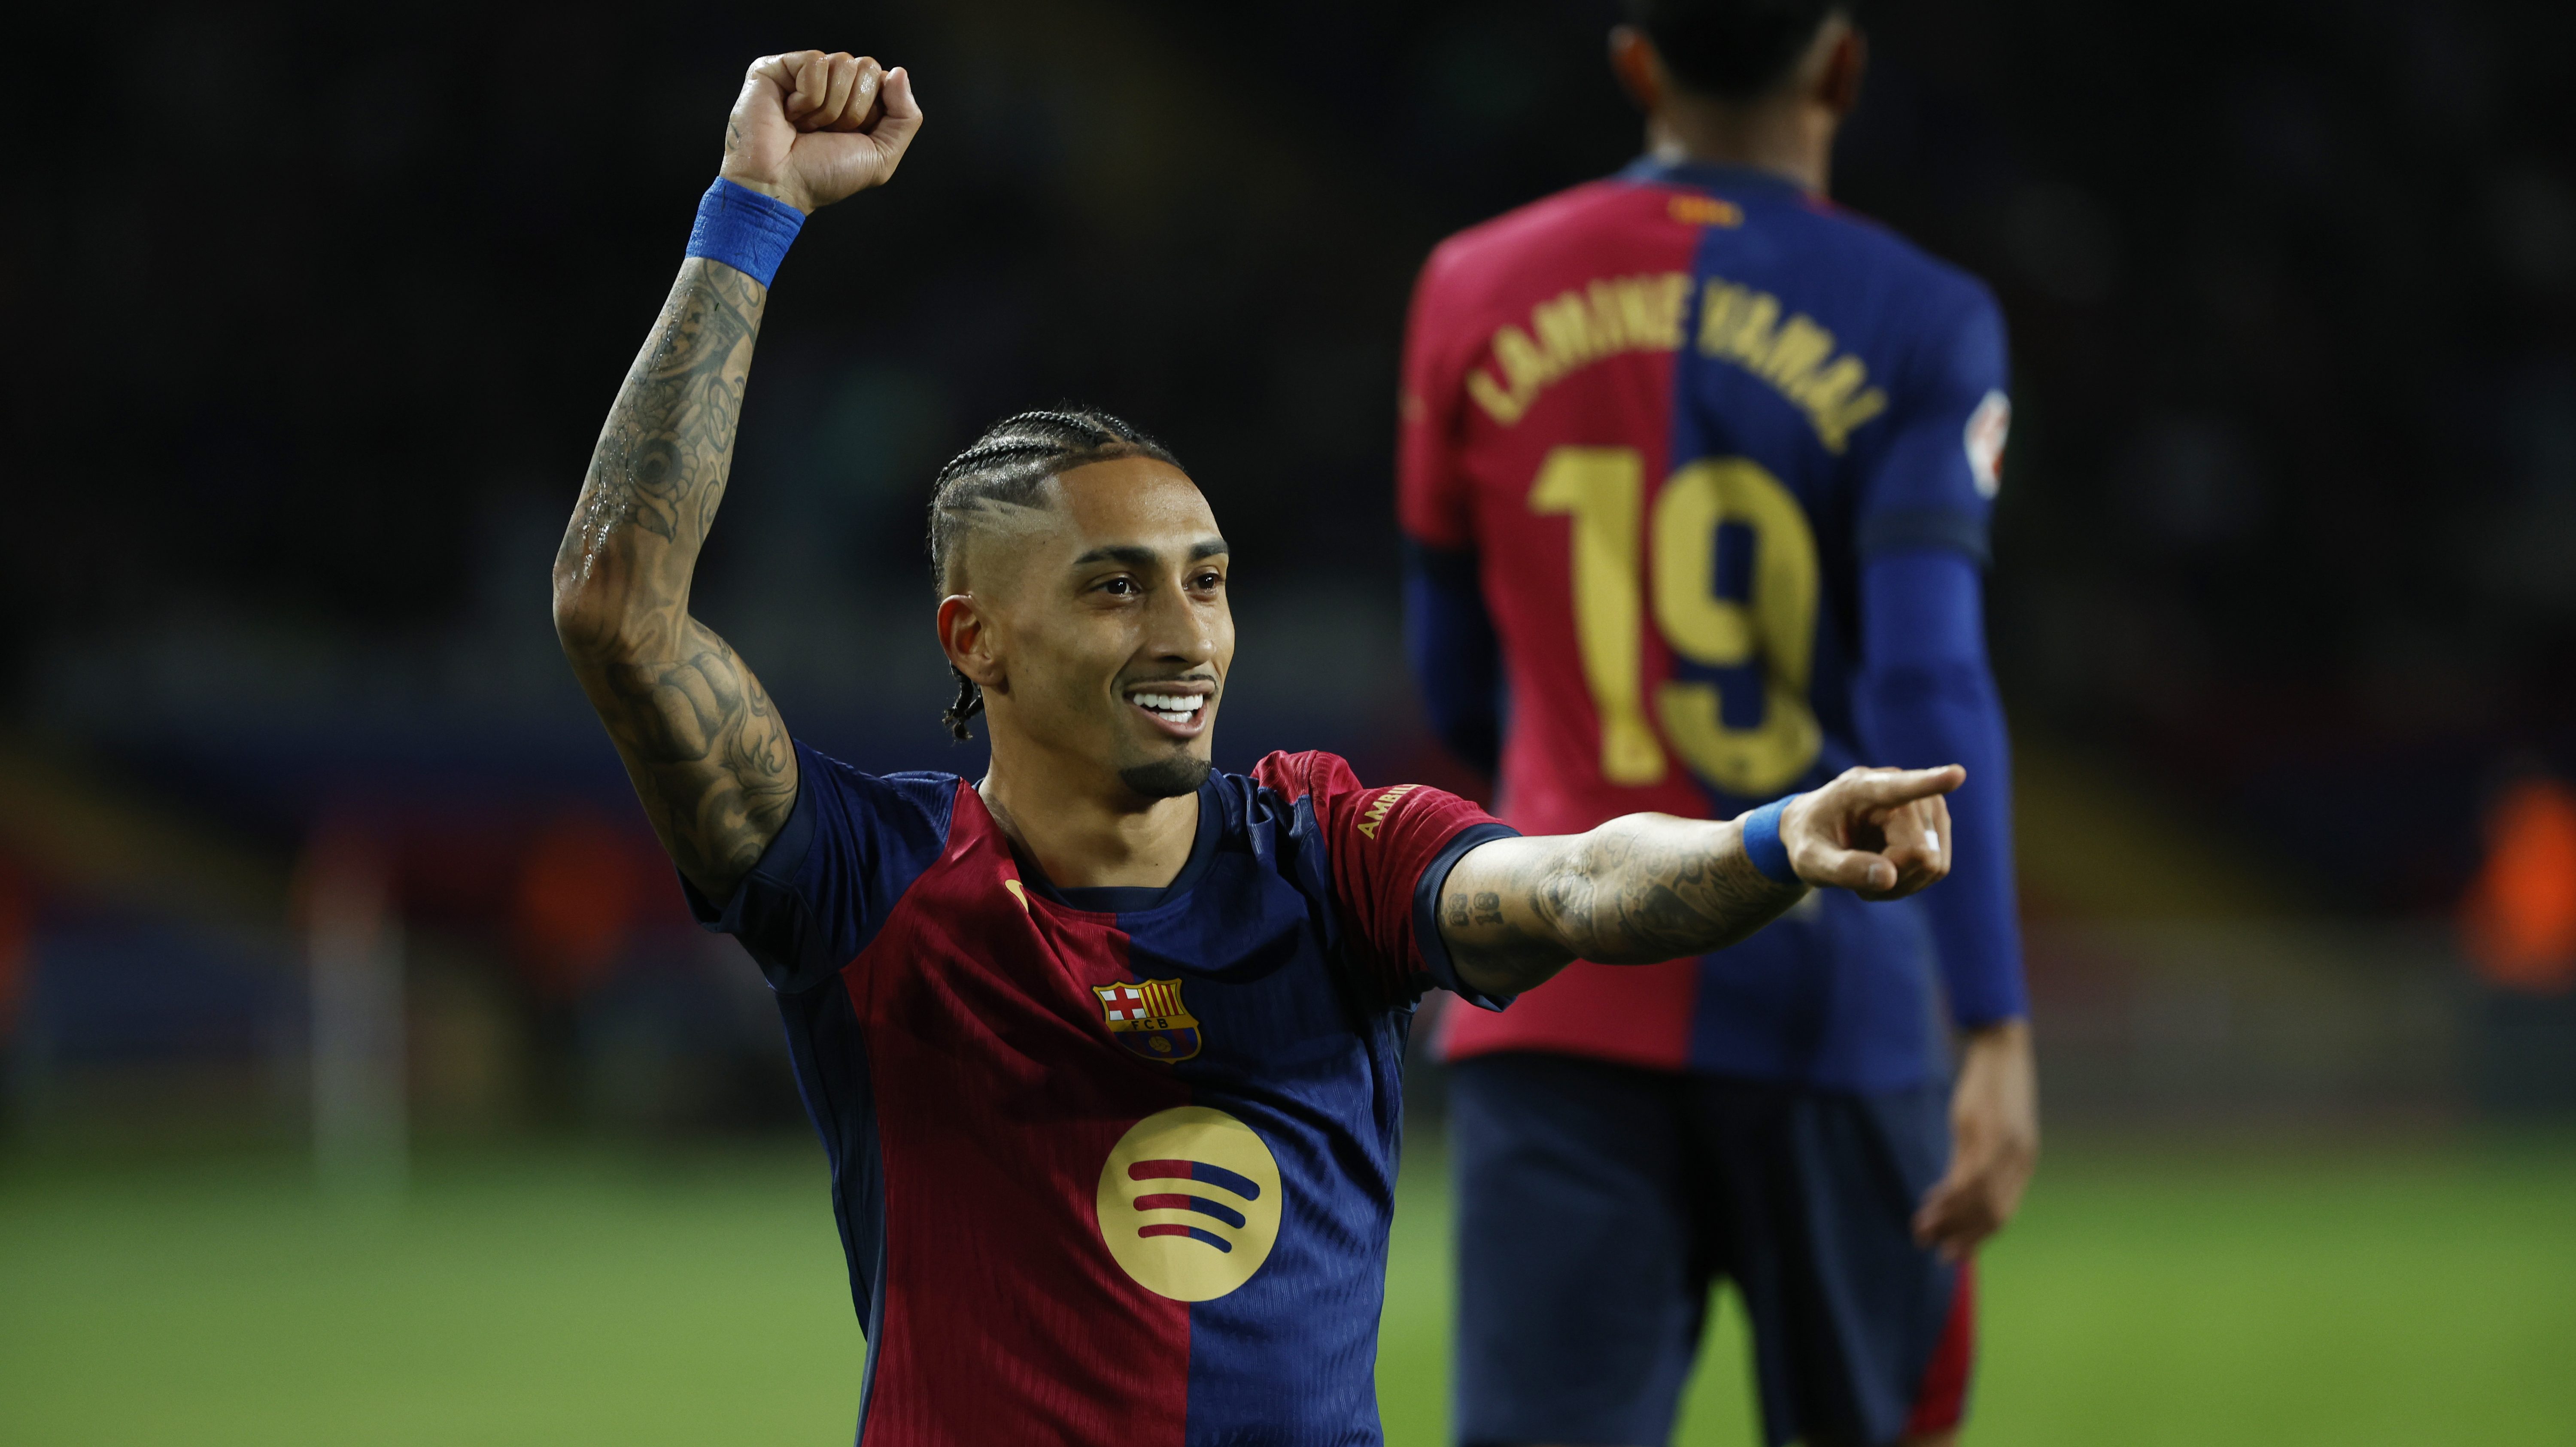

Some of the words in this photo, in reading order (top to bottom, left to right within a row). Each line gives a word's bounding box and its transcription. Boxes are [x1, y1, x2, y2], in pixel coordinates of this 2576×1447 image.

[1467, 272, 1690, 425] LAMINE
[1699, 277, 1886, 455] YAMAL
[1528, 446, 1822, 796] 19
[1131, 1018, 1168, 1030] FCB
